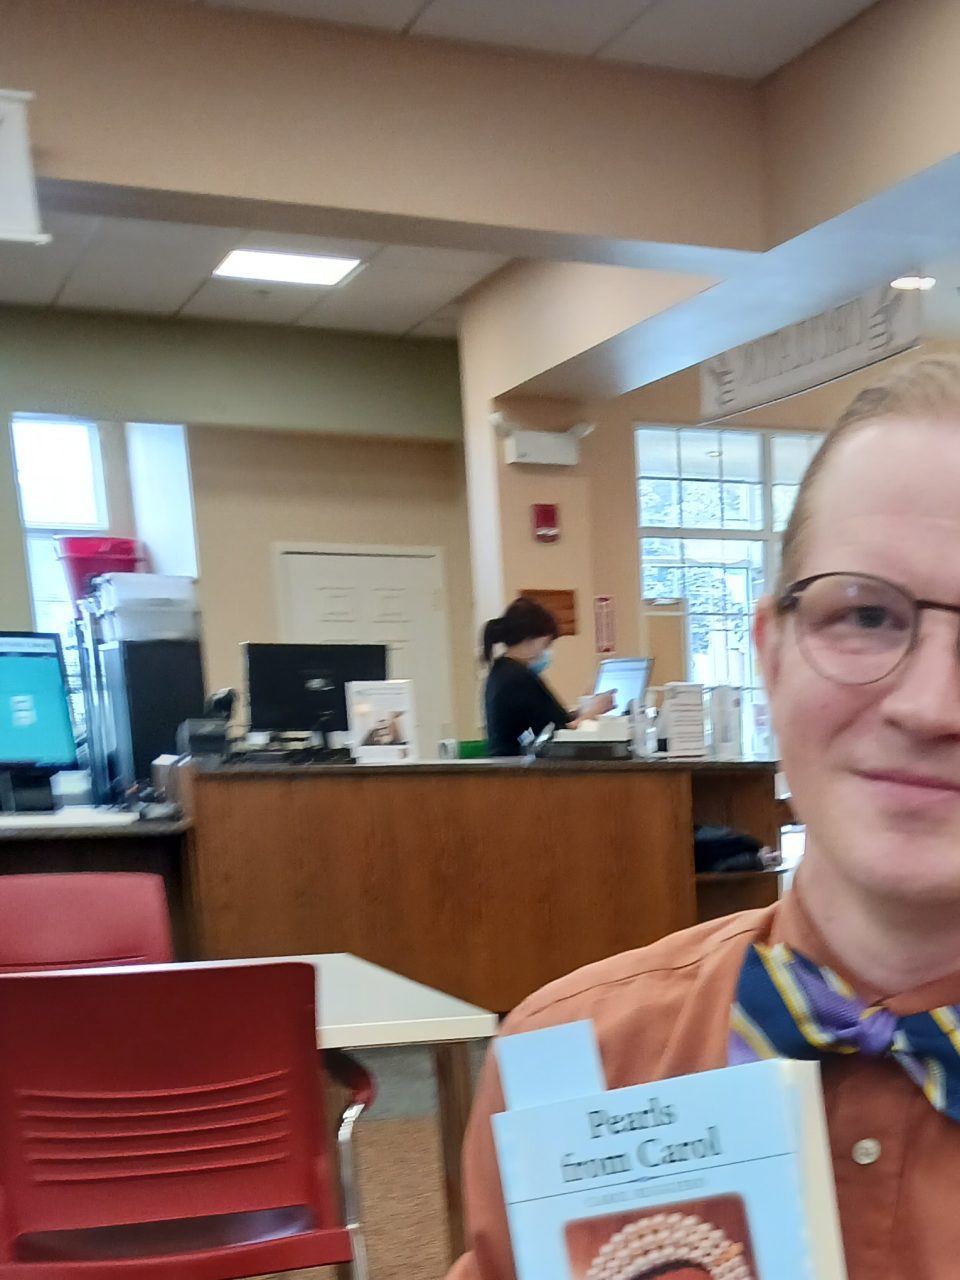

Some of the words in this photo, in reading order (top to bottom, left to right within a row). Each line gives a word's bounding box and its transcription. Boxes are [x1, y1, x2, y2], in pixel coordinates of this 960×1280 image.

[587, 1097, 678, 1139] Pearls
[560, 1152, 632, 1183] from
[635, 1125, 723, 1168] Carol
